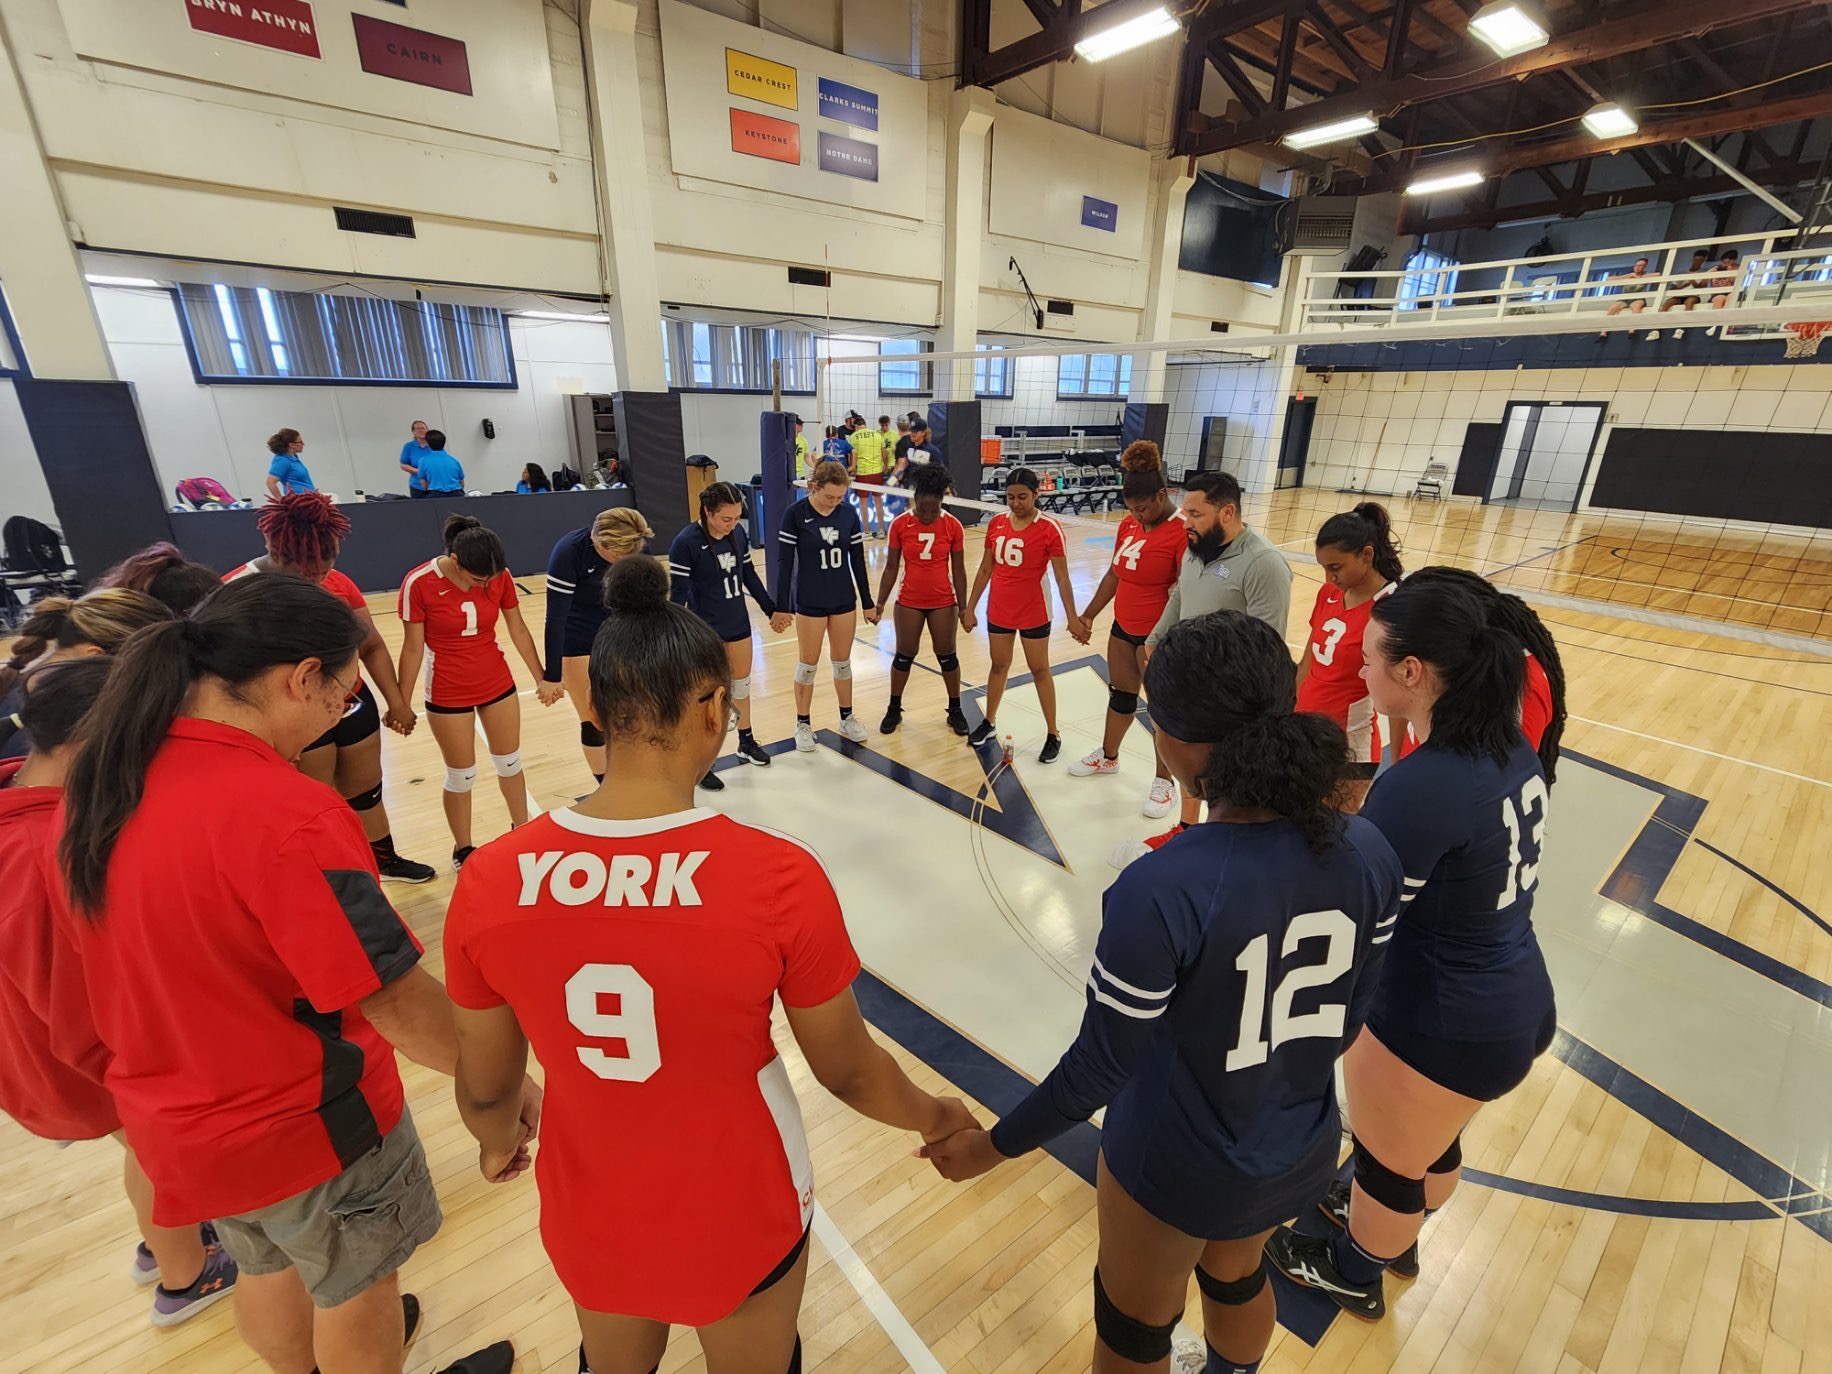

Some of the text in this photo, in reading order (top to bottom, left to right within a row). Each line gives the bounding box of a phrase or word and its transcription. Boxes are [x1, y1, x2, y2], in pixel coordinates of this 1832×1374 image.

[251, 8, 311, 35] ATHYN
[386, 43, 442, 65] CAIRN
[734, 69, 792, 91] CEDAR CREST
[819, 92, 878, 115] CLARKS SUMMIT
[745, 129, 788, 145] KEYSTONE
[826, 148, 872, 165] NOTRE DAME
[855, 432, 875, 440] STAFF
[819, 526, 839, 546] VF
[918, 533, 935, 560] 7
[717, 552, 737, 573] VF
[820, 547, 842, 570] 10
[995, 536, 1024, 567] 16
[1113, 535, 1146, 570] 14
[723, 575, 741, 599] 11
[460, 601, 478, 637] 1
[1312, 617, 1347, 667] 3
[1496, 774, 1549, 910] 13
[517, 851, 710, 907] YORK
[1225, 909, 1357, 1072] 12
[565, 963, 661, 1083] 9
